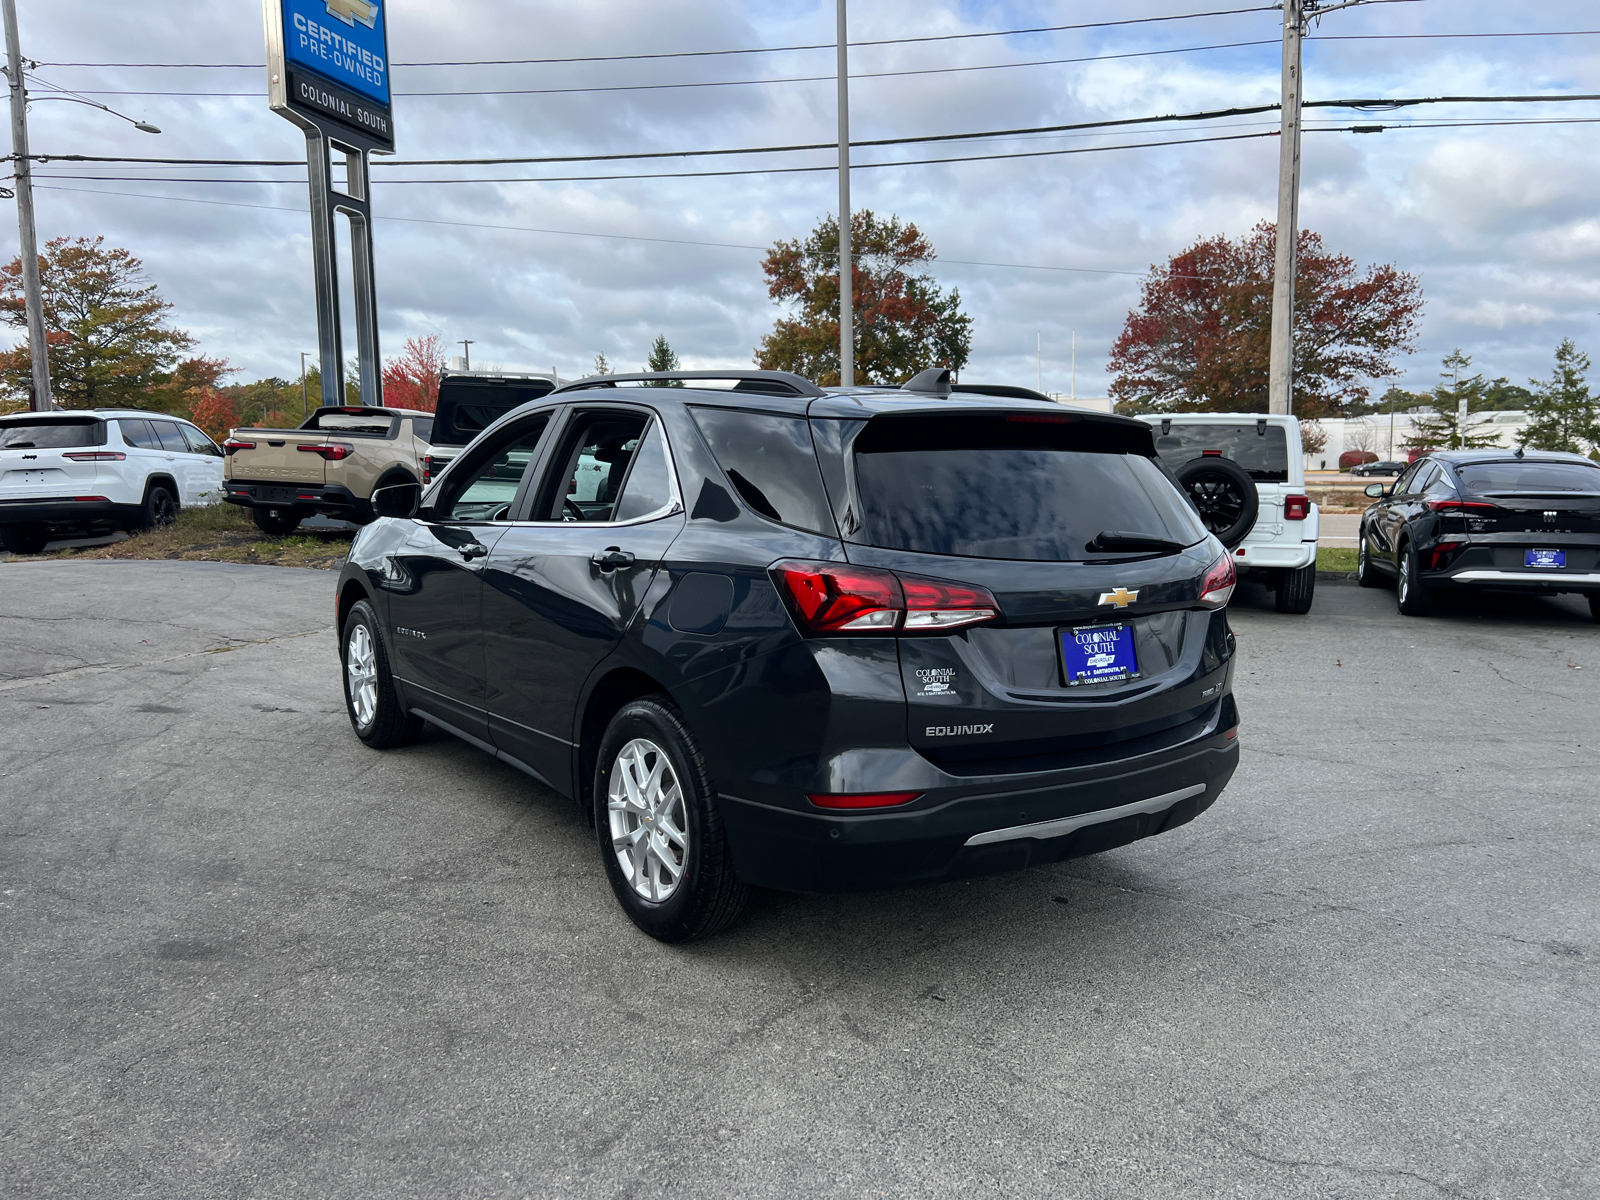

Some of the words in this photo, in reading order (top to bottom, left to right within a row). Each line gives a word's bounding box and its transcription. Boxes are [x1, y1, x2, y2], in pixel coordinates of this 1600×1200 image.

[293, 12, 384, 72] CERTIFIED
[300, 33, 382, 87] PRE-OWNED
[301, 82, 352, 118] COLONIAL
[357, 108, 387, 133] SOUTH
[235, 465, 278, 476] SANTA
[281, 469, 320, 478] CRUZ
[1075, 630, 1120, 644] COLONIAL
[1084, 642, 1115, 655] SOUTH
[916, 668, 955, 677] COLONIAL
[922, 675, 950, 683] SOUTH
[925, 723, 994, 737] EQUINOX
